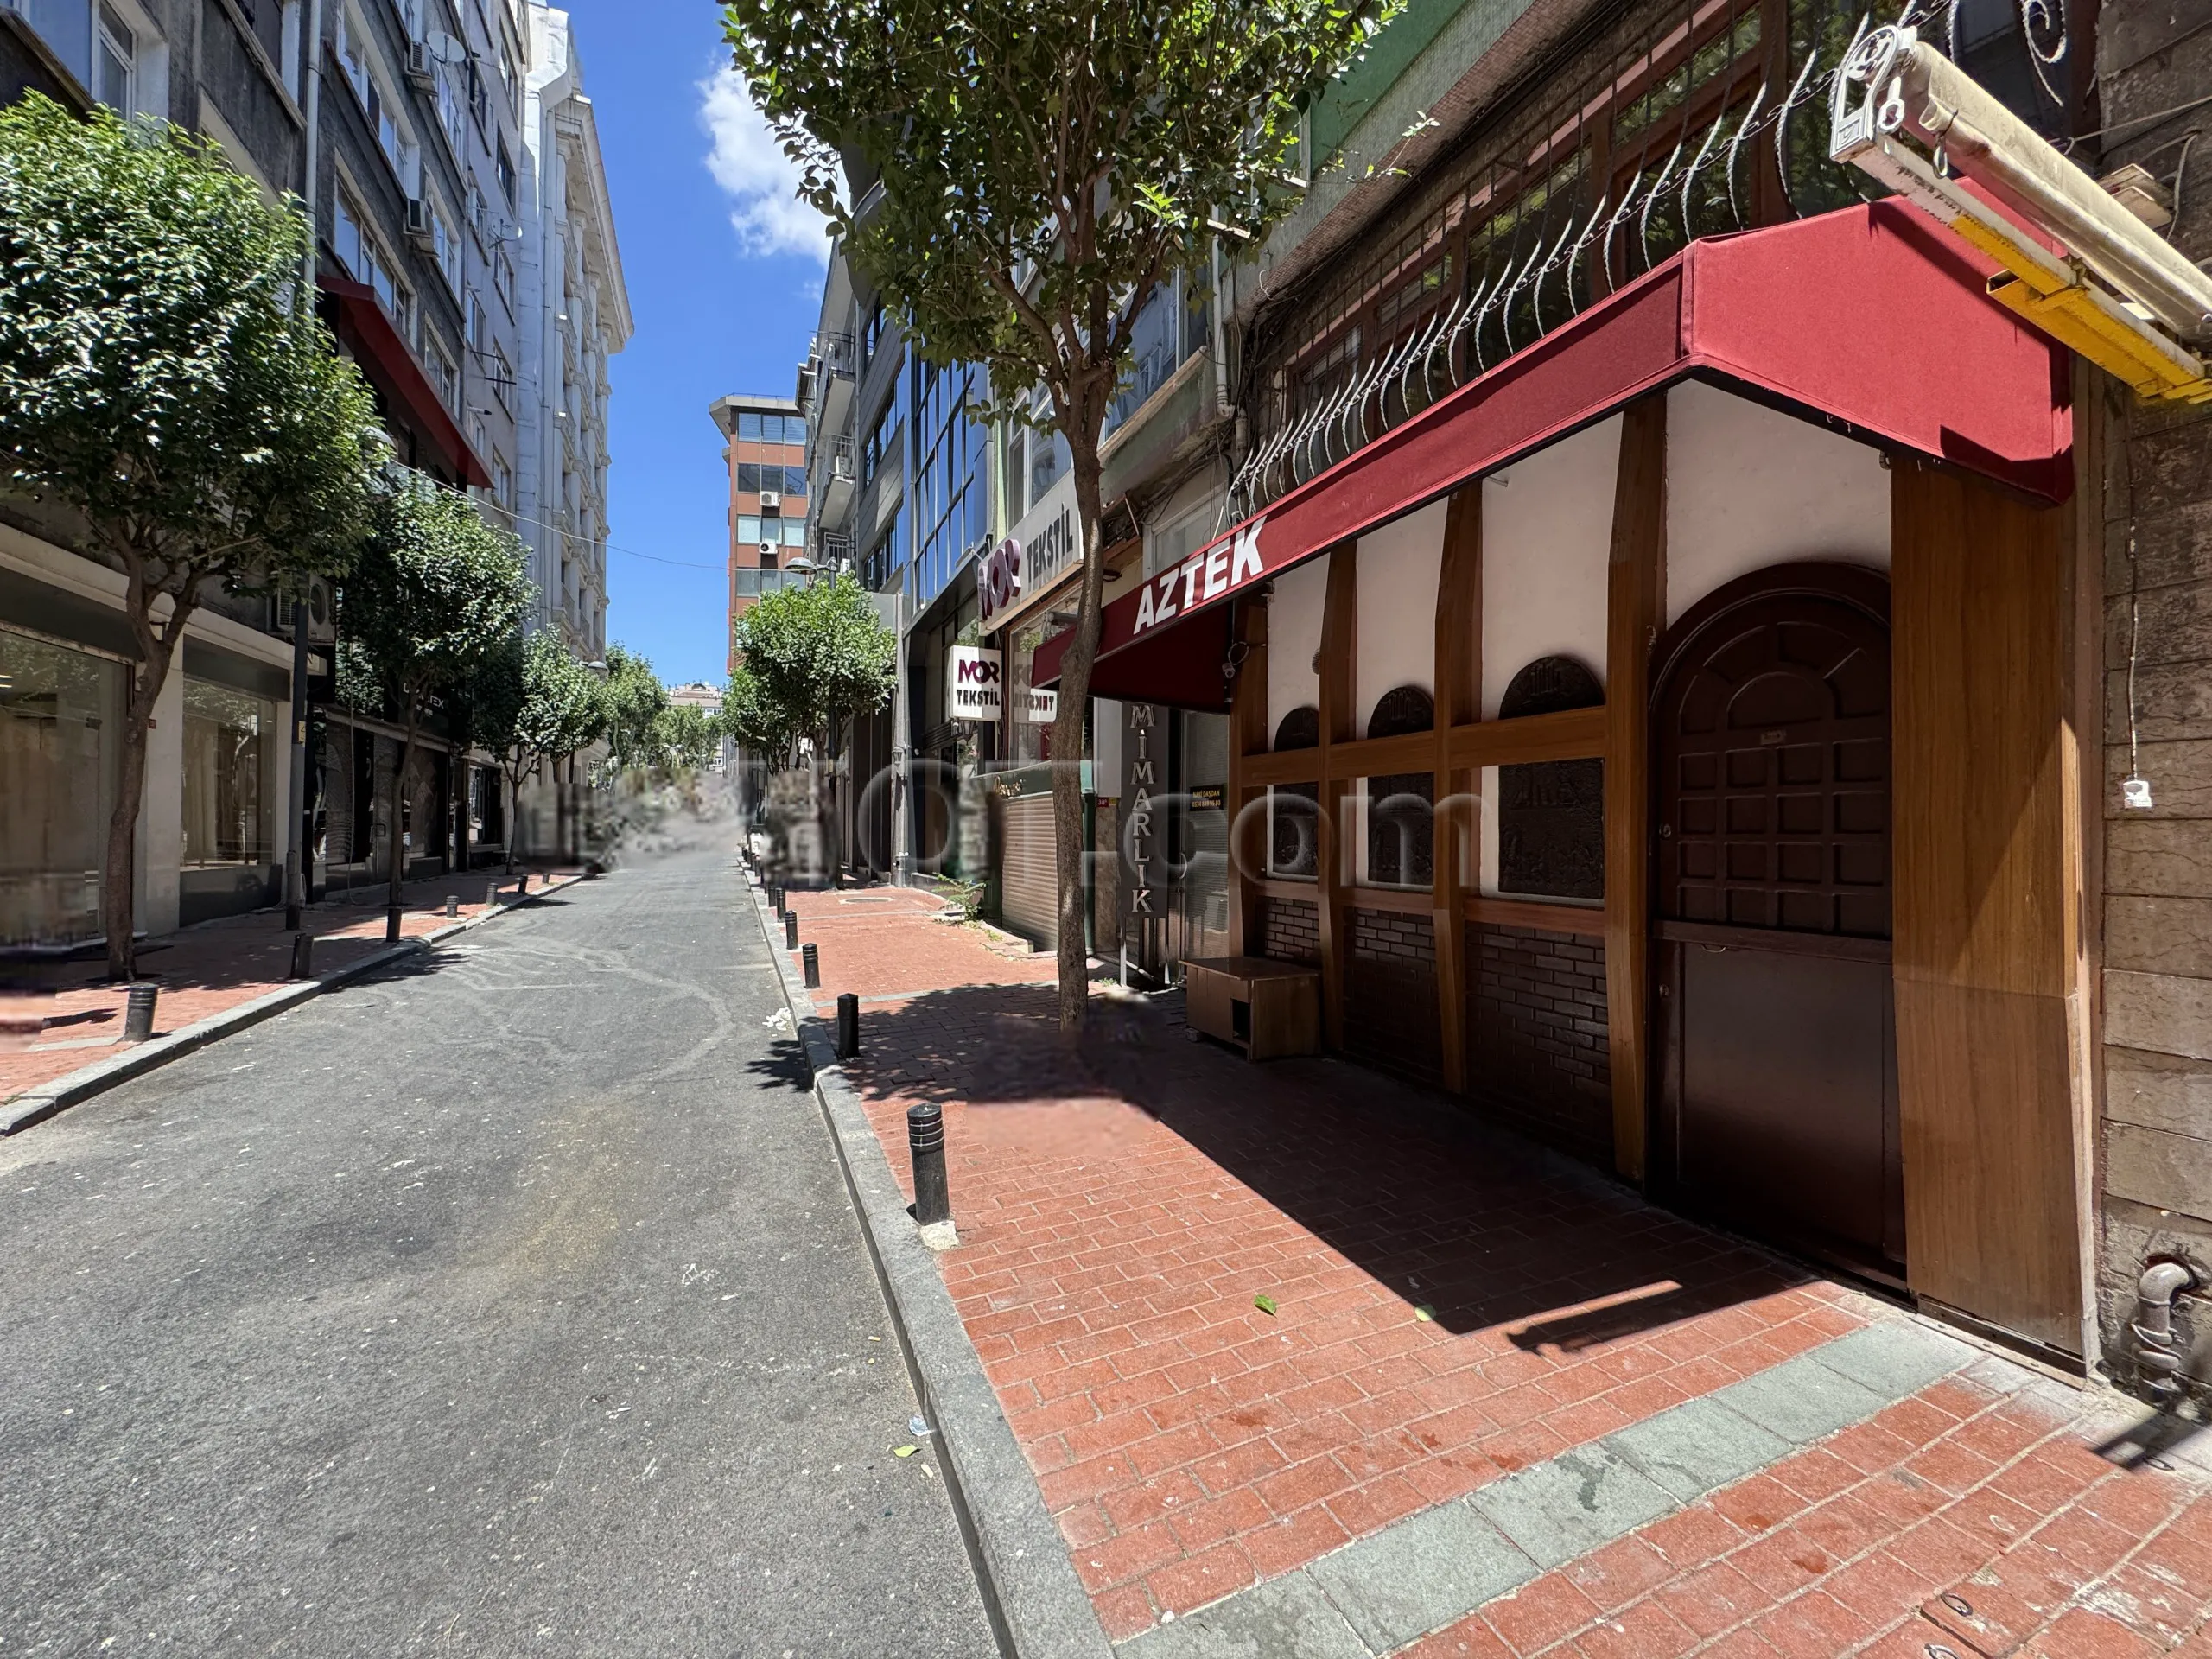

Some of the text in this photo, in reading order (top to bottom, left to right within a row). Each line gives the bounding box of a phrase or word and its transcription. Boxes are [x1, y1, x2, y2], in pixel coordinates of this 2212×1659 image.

[978, 502, 1073, 620] MOR TEKSTİL
[1133, 515, 1268, 635] AZTEK
[957, 688, 1000, 707] TEKSTİL
[958, 659, 1000, 684] MOR
[1130, 705, 1155, 913] MİMARLIK
